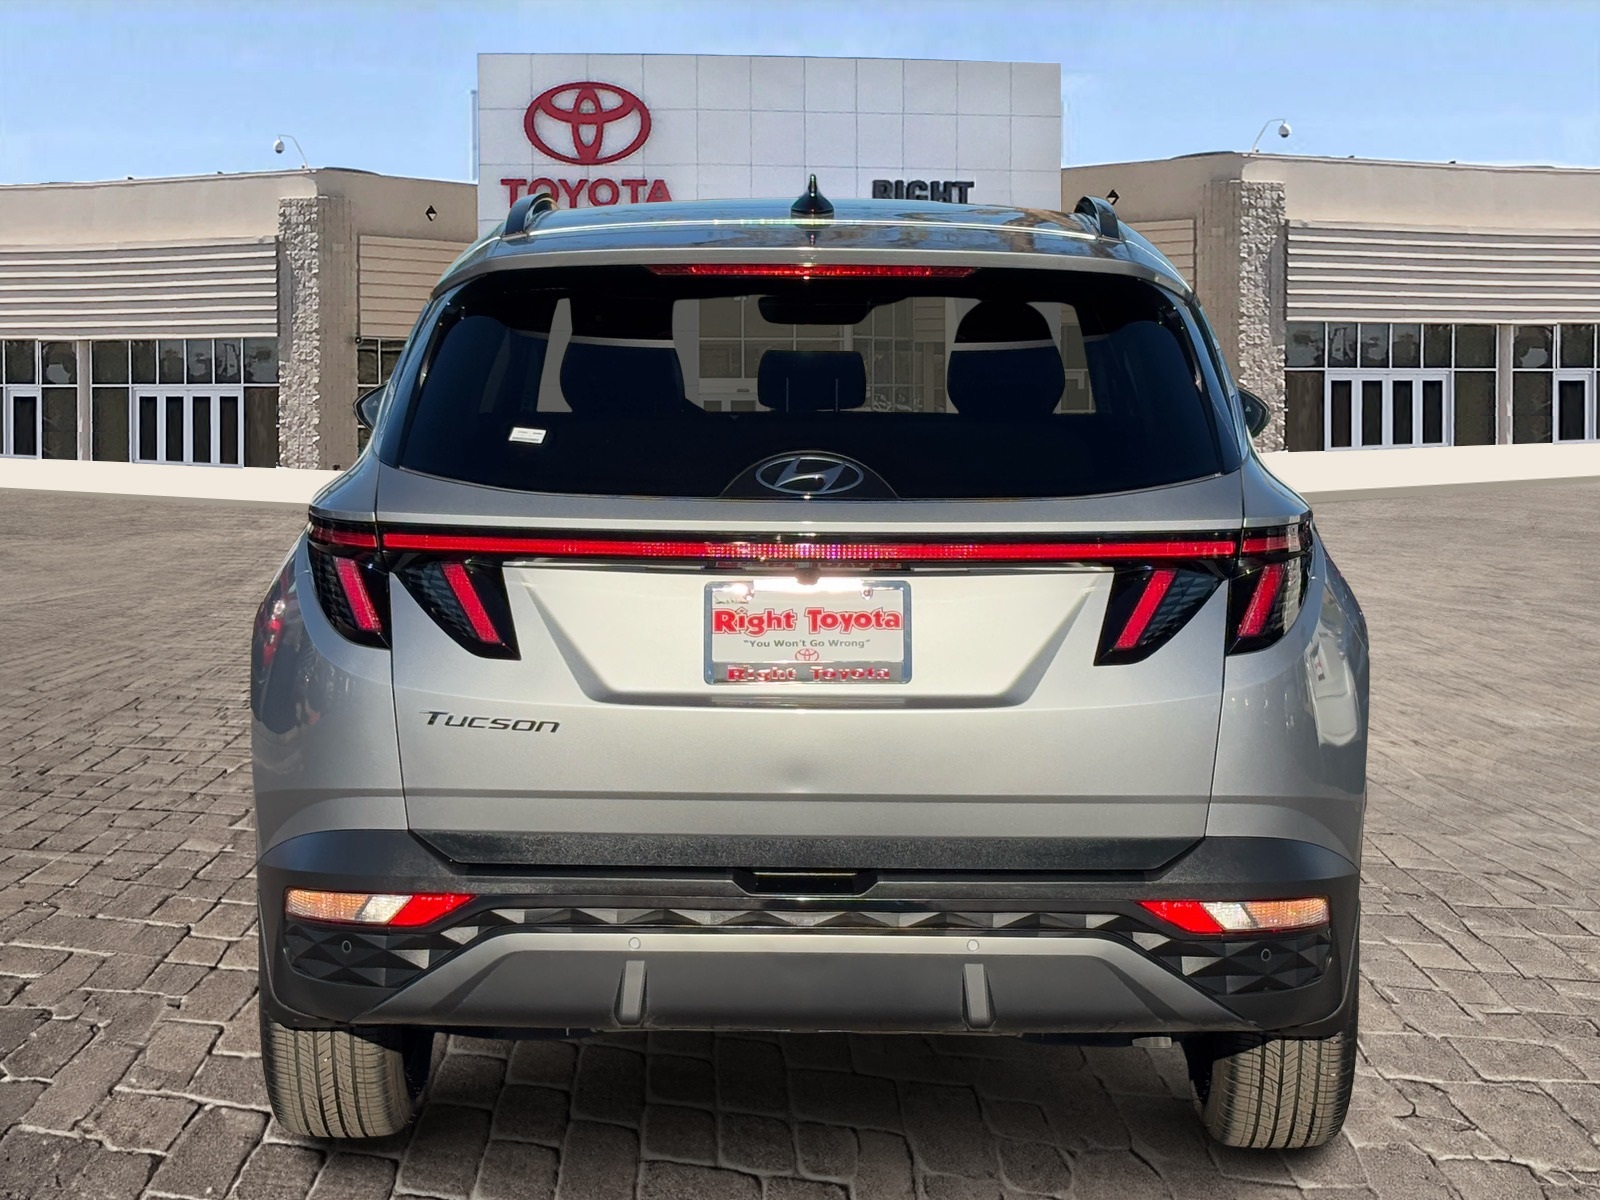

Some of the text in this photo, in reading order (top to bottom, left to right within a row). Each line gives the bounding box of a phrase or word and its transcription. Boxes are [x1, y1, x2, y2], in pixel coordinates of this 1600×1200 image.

[500, 177, 673, 208] TOYOTA
[872, 179, 975, 204] RIGHT
[712, 606, 903, 637] Right Toyota
[809, 639, 825, 648] Go
[727, 665, 890, 682] Right Toyota
